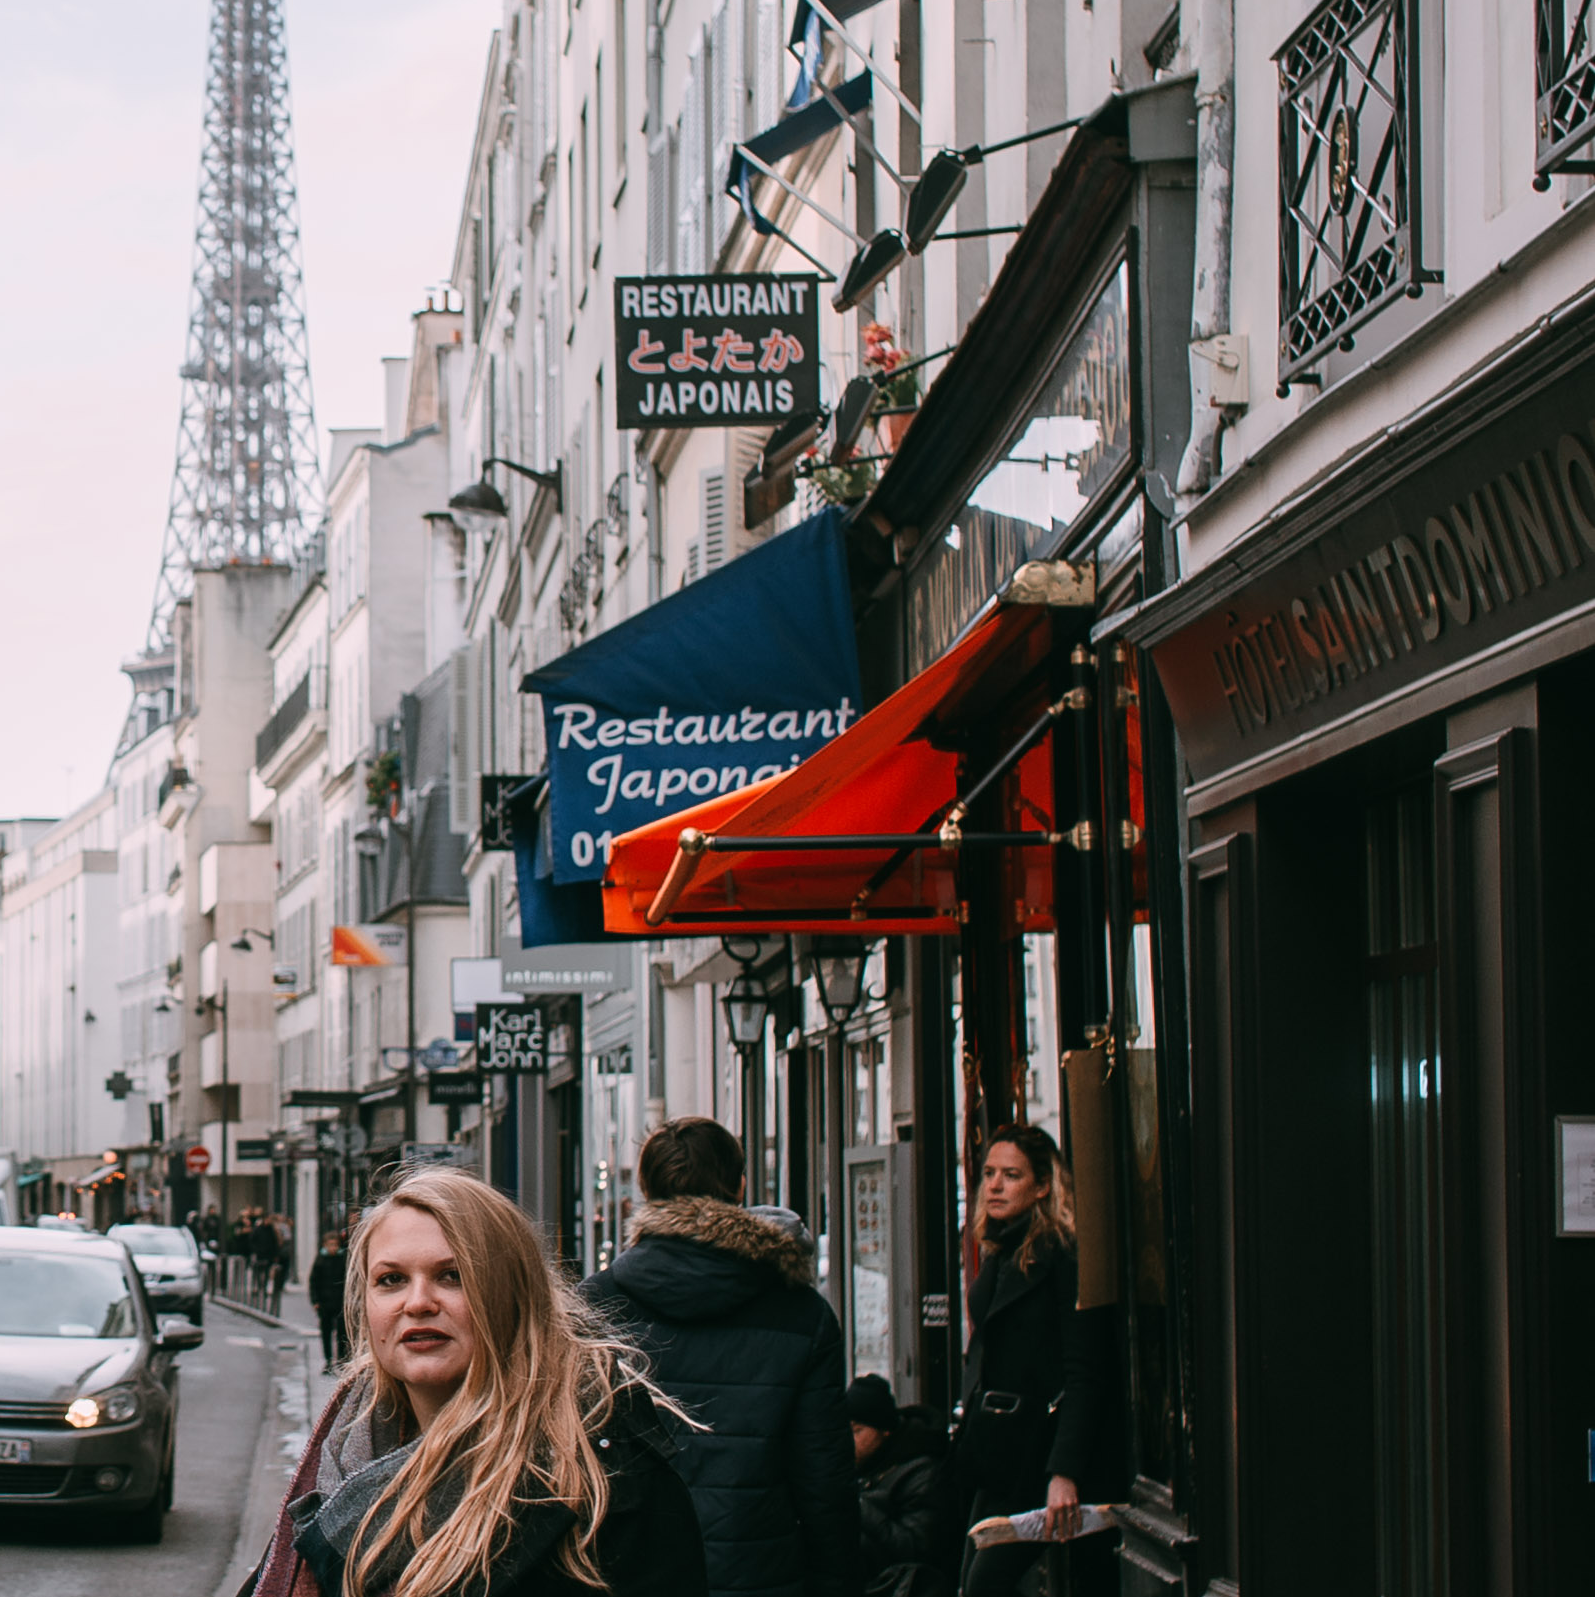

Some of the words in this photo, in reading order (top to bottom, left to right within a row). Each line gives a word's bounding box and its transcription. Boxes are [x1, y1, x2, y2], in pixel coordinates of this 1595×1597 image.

[622, 281, 808, 318] RESTAURANT
[627, 327, 805, 374] とよたか
[638, 379, 795, 416] JAPONAIS
[553, 696, 856, 750] Restaurant
[571, 829, 612, 868] 01
[505, 969, 613, 984] intimissimi
[478, 1025, 544, 1051] Marc
[489, 1008, 542, 1032] Karl
[480, 1041, 544, 1068] John
